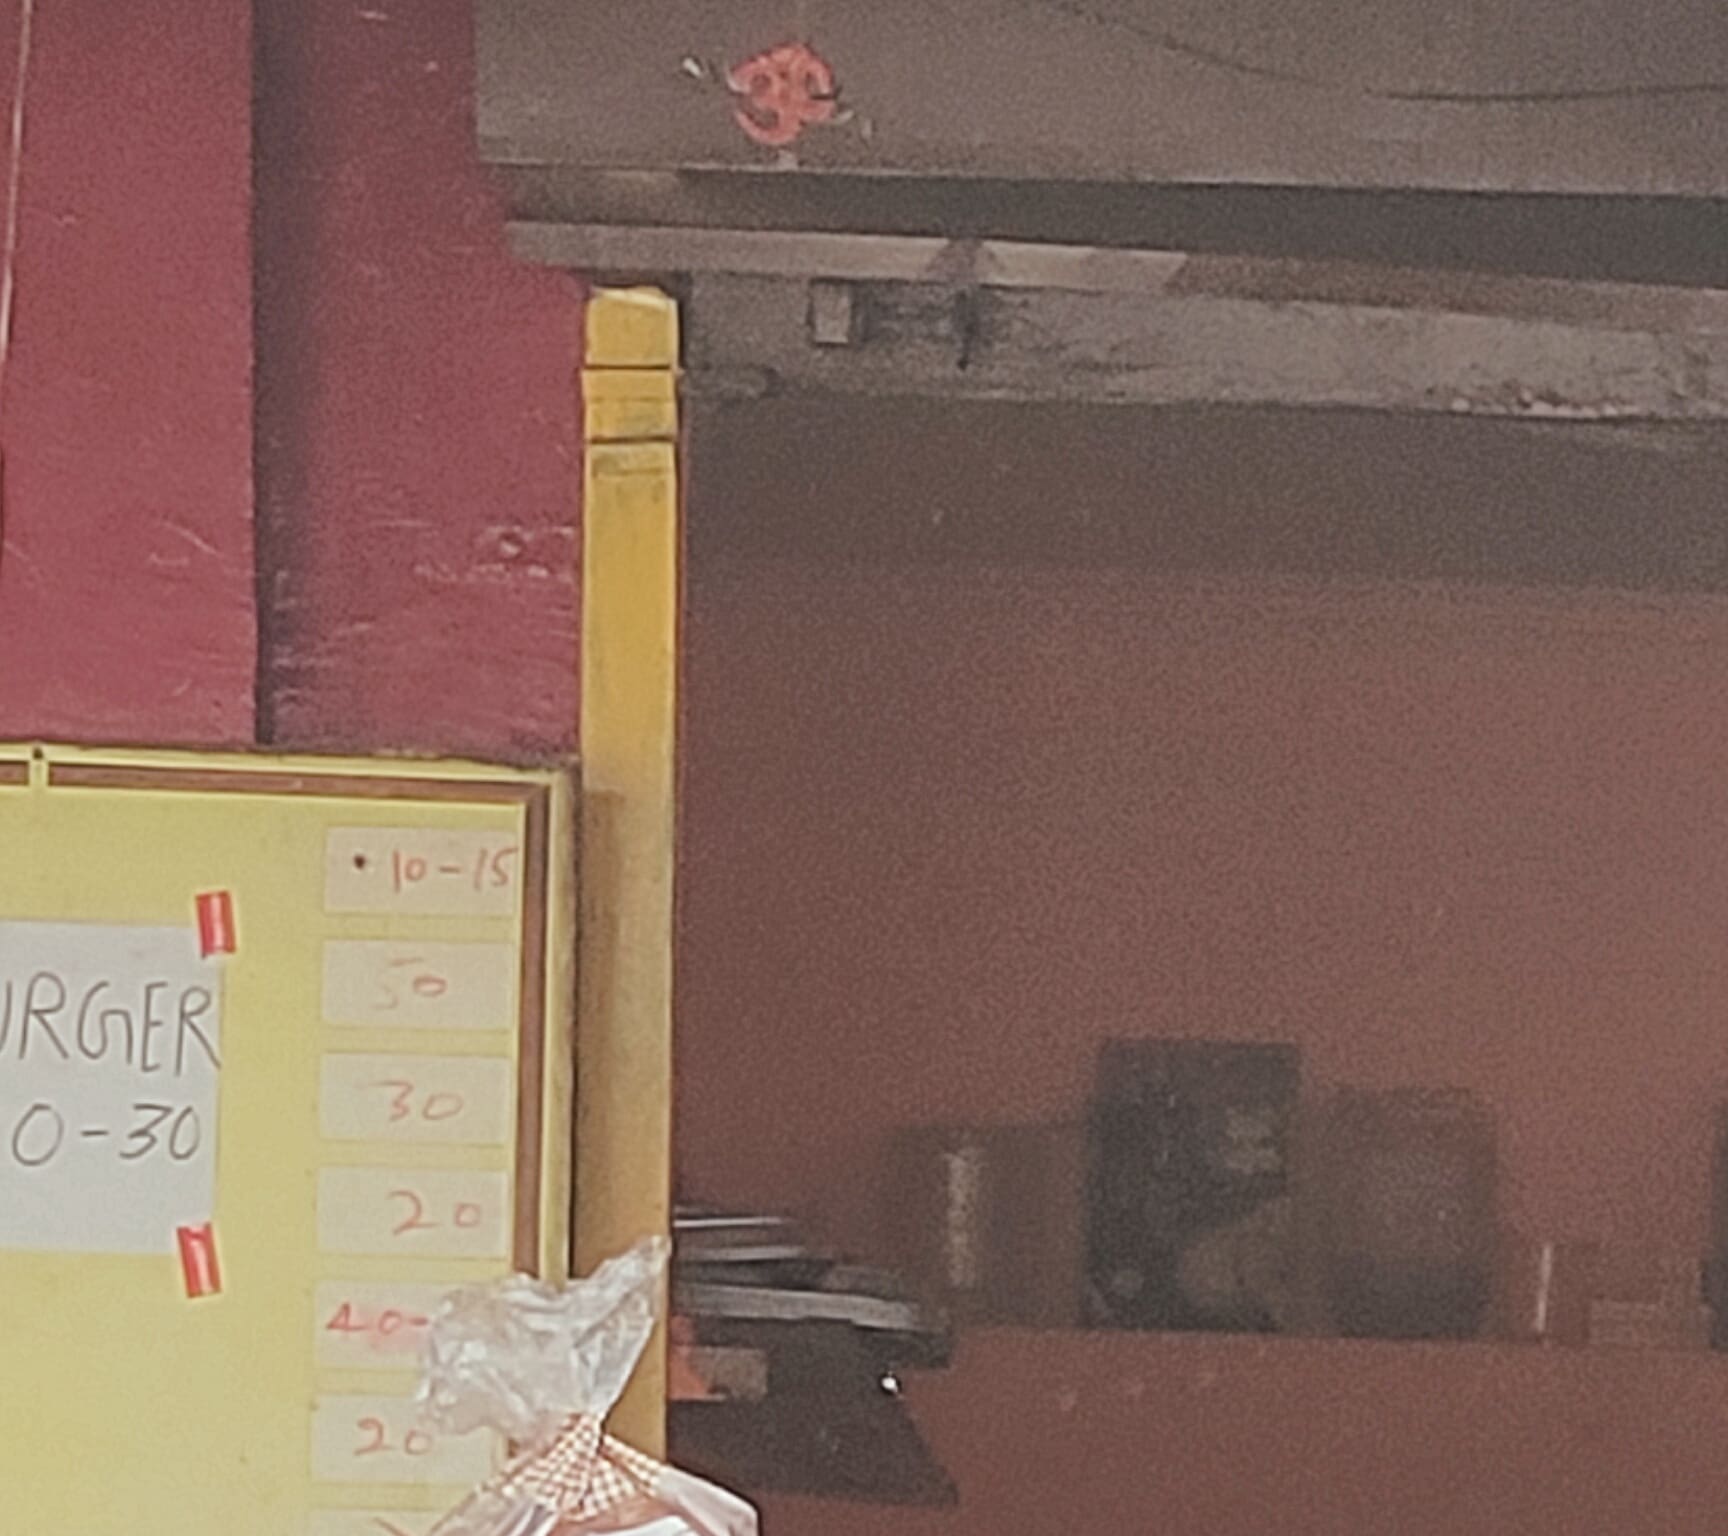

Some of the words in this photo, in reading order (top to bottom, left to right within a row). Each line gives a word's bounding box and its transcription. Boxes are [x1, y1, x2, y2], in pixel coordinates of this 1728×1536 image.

[391, 846, 520, 894] 10-15
[391, 1190, 482, 1236] 20
[354, 1417, 434, 1456] 20
